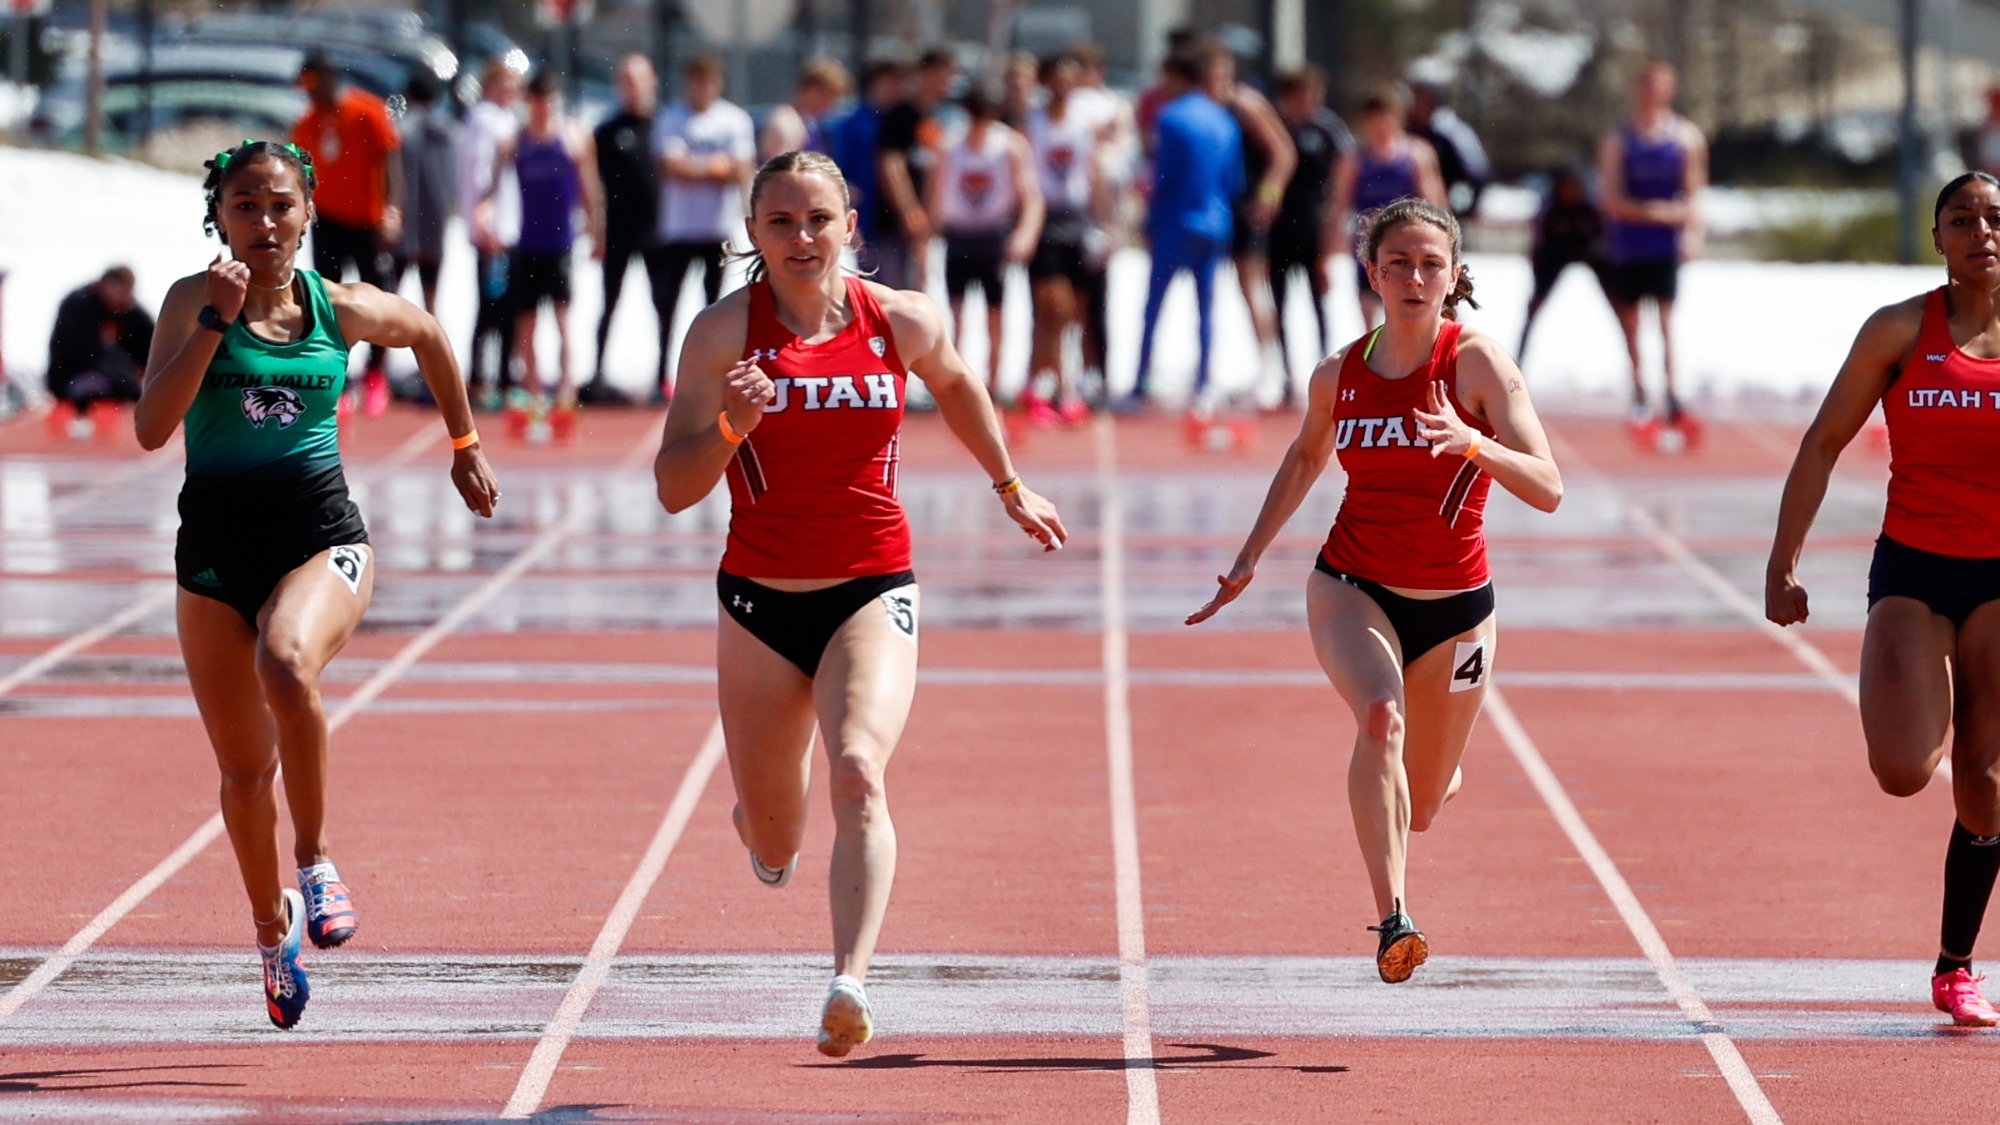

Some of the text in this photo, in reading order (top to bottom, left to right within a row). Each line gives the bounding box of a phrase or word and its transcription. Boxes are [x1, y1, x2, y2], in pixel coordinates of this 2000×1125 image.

[211, 372, 337, 390] UTAH VALLEY
[1908, 389, 1981, 408] UTAH
[894, 597, 914, 635] 5
[1454, 646, 1483, 685] 4
